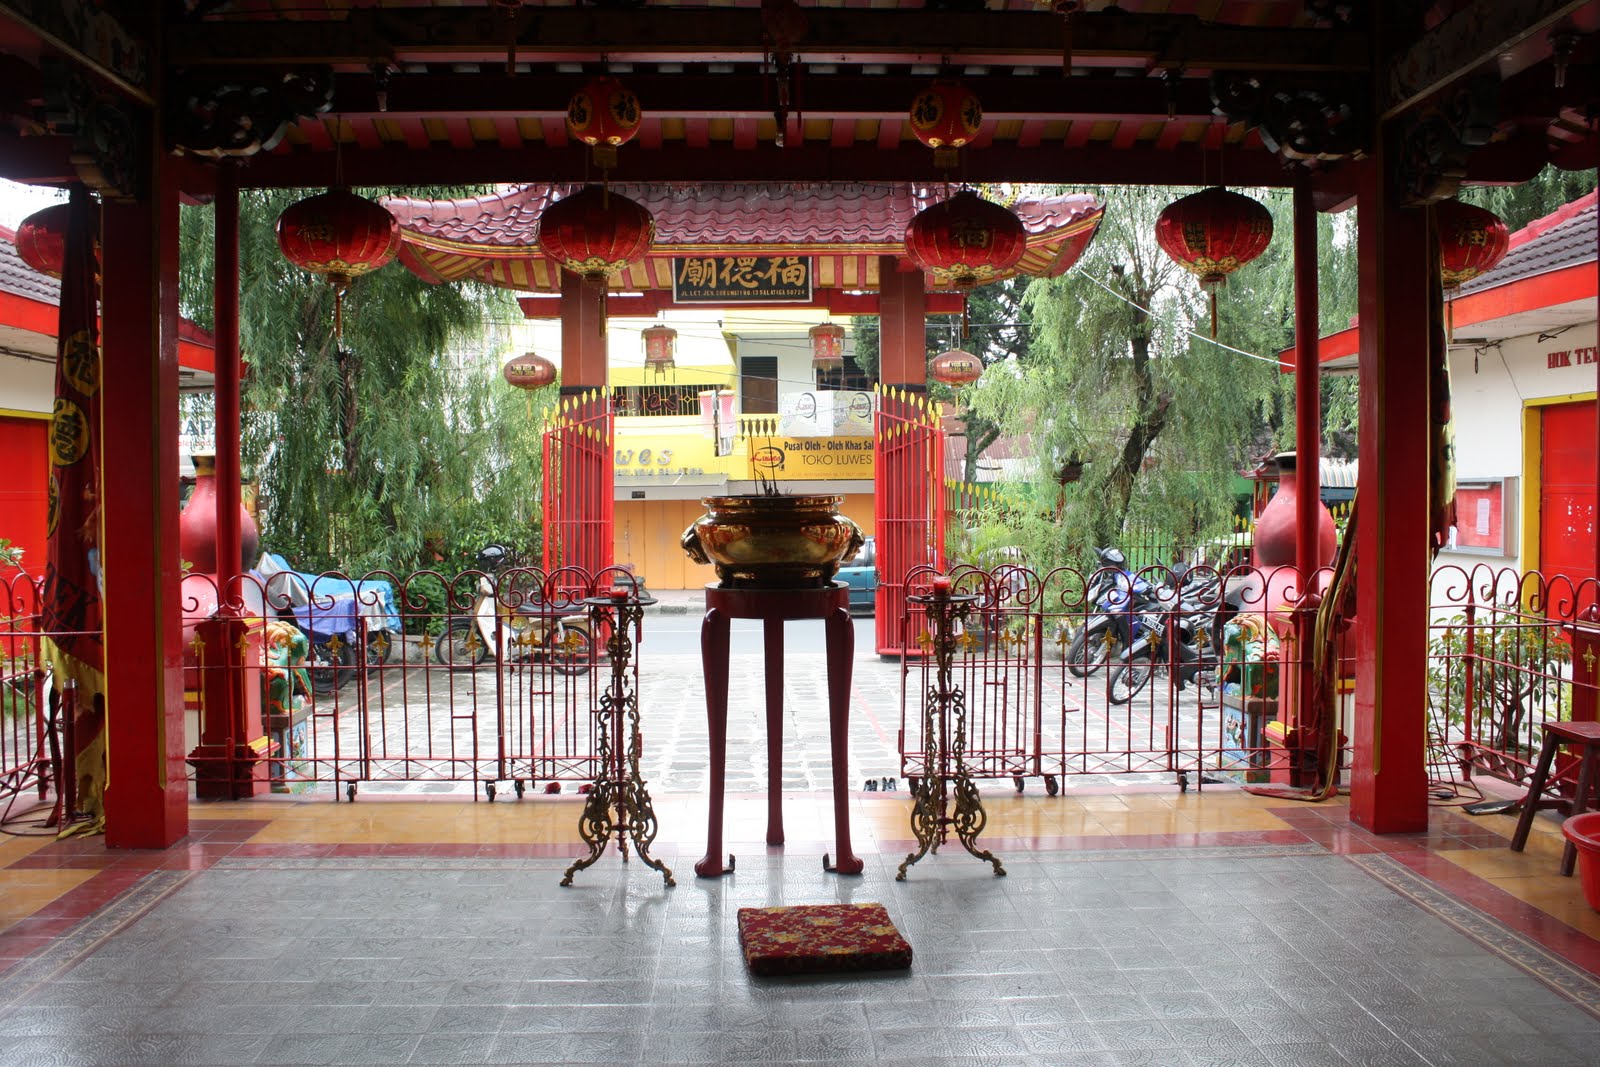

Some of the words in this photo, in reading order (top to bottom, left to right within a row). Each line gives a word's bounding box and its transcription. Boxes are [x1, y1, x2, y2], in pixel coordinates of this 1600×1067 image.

[1547, 350, 1572, 369] HOK
[784, 441, 803, 451] Pusat
[805, 440, 821, 451] Oleh
[827, 440, 844, 451] Oleh
[845, 440, 862, 450] Khas
[802, 454, 834, 466] TOKO
[836, 454, 873, 465] LUWES
